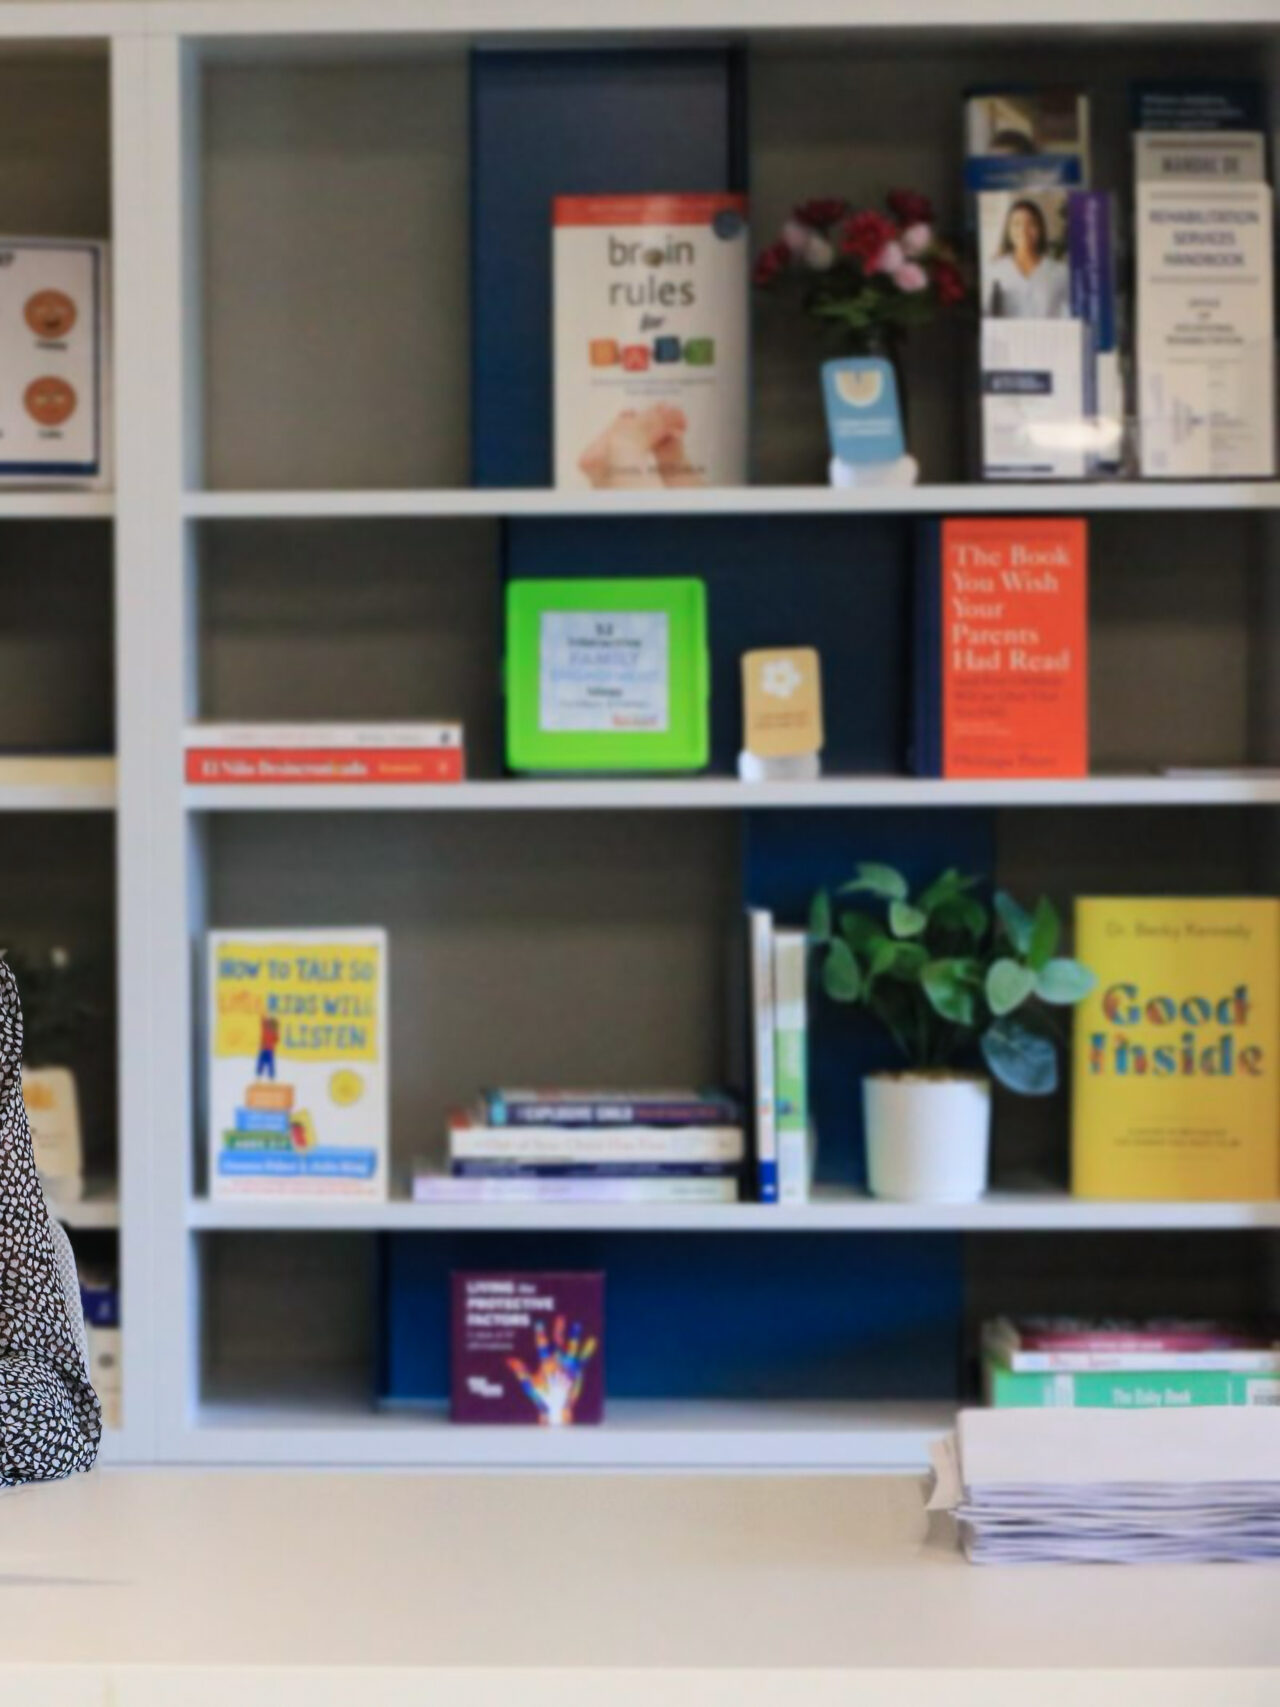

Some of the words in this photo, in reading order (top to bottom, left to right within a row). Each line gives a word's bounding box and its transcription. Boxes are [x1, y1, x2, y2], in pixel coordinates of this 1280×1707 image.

[609, 275, 696, 306] rules
[953, 545, 1002, 566] The
[1010, 544, 1071, 566] Book
[951, 571, 996, 592] You
[1001, 570, 1059, 592] Wish
[951, 597, 1004, 619] Your
[951, 623, 1041, 645] Parents
[951, 649, 1001, 671] Had
[1009, 649, 1071, 672] Read
[219, 959, 261, 979] HOW
[268, 960, 291, 979] TO
[296, 958, 343, 981] TALK
[349, 962, 374, 981] SO
[268, 995, 318, 1015] KIDS
[1102, 981, 1252, 1027] Good
[284, 1025, 367, 1049] LISTEN
[1088, 1031, 1265, 1077] Inside
[467, 1297, 555, 1311] PROTECTIVE
[467, 1313, 530, 1327] FACTORS
